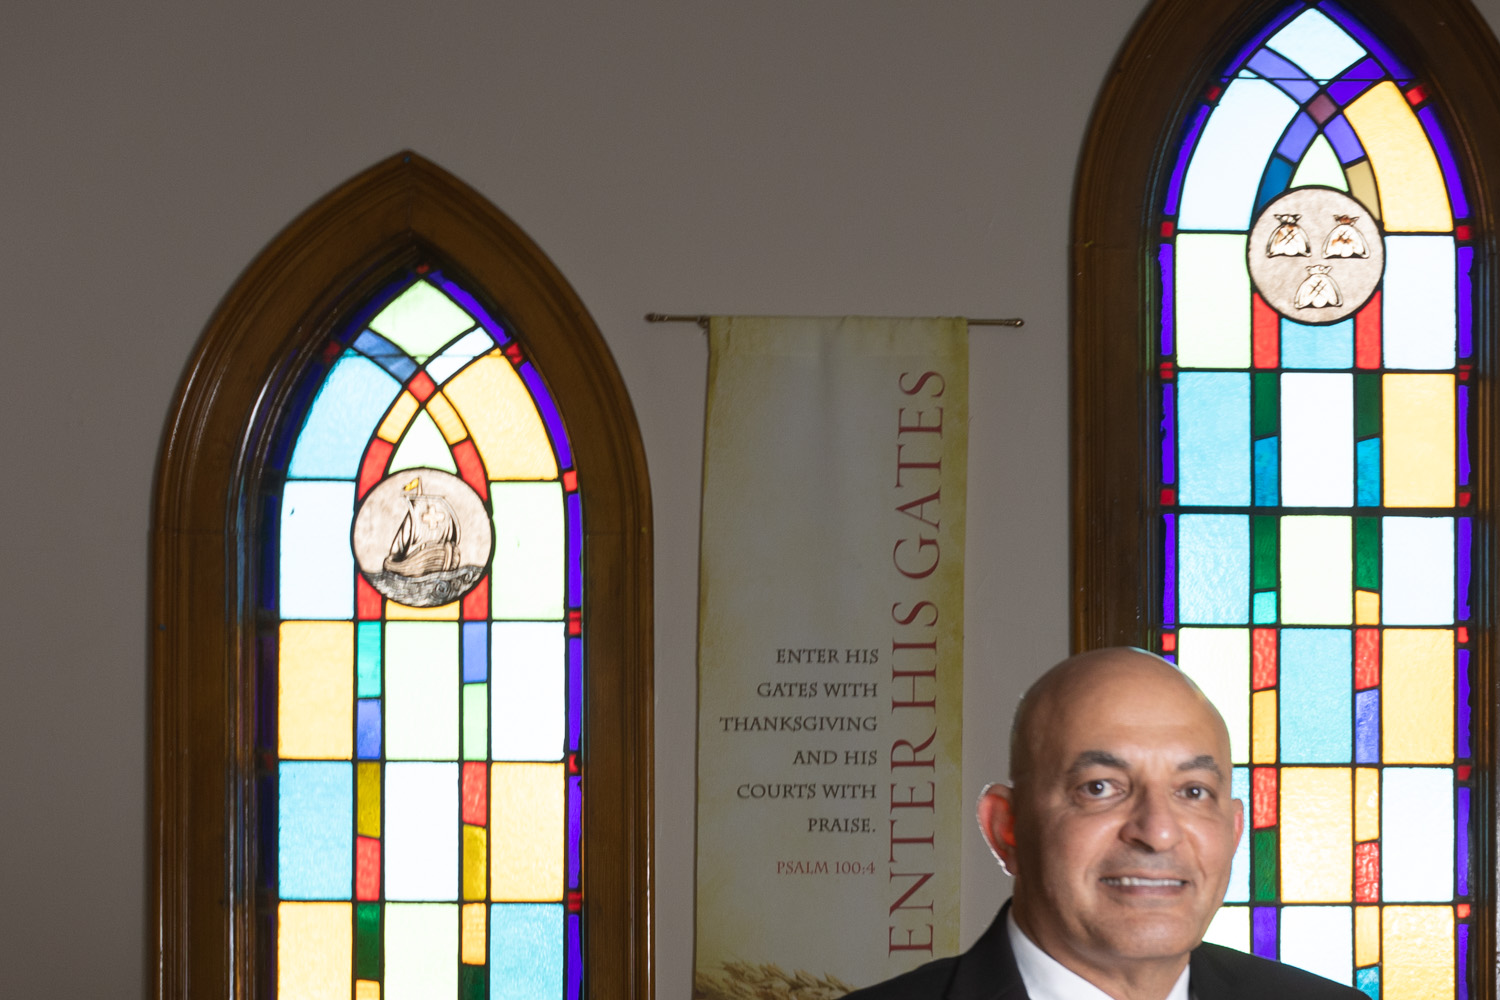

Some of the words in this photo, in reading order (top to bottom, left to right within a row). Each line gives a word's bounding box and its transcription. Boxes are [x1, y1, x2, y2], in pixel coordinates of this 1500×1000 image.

[893, 370, 946, 579] GATES
[776, 648, 839, 664] ENTER
[845, 648, 879, 664] HIS
[891, 600, 939, 714] HIS
[757, 682, 818, 698] GATES
[823, 682, 878, 698] WITH
[719, 716, 878, 732] THANKSGIVING
[792, 750, 838, 765] AND
[844, 750, 878, 766] HIS
[736, 783, 816, 800] COURTS
[822, 784, 877, 799] WITH
[807, 817, 876, 834] PRAISE.
[888, 727, 937, 957] ENTER
[776, 860, 829, 875] PSALM
[835, 860, 875, 875] 100:4
